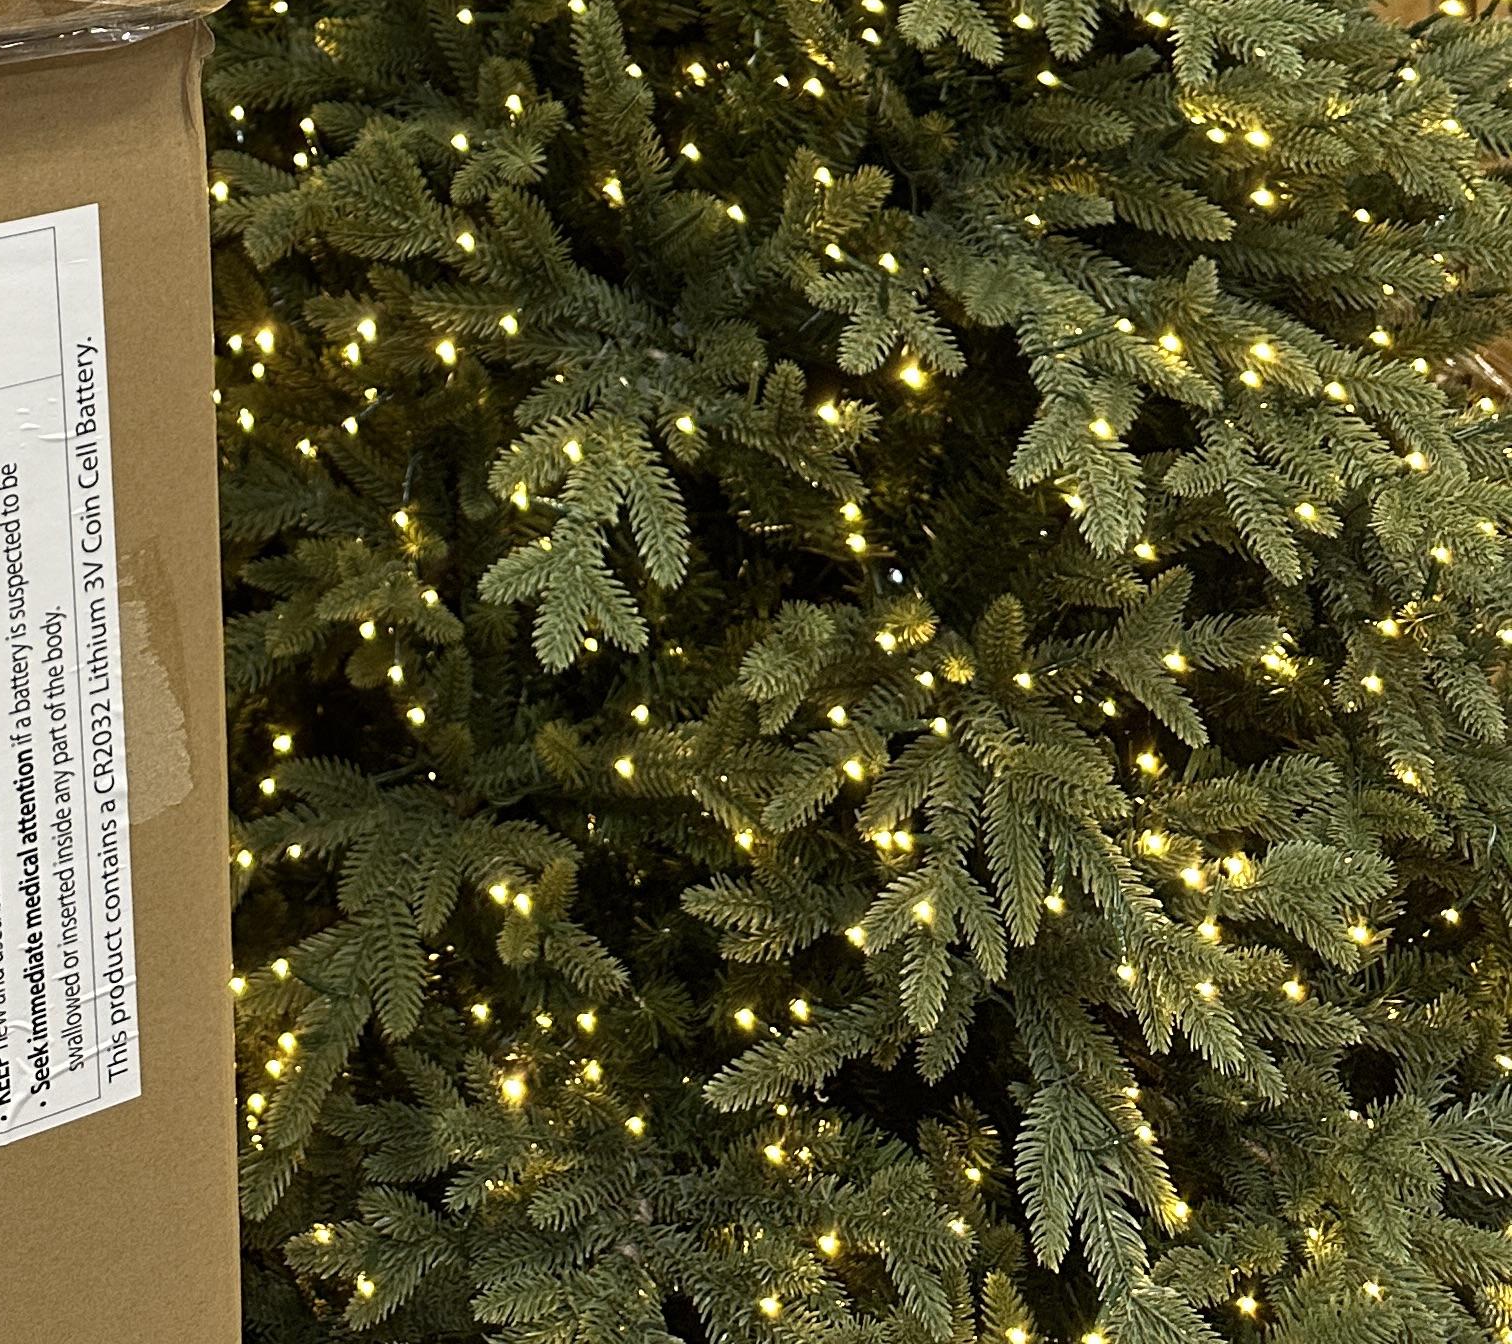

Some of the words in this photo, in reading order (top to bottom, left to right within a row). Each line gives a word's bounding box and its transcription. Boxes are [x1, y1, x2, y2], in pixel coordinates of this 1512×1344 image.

[76, 337, 98, 436] Battery.
[76, 442, 98, 488] Cell
[81, 495, 102, 553] Coin
[83, 563, 104, 592] 3V
[87, 598, 109, 695] Lithium
[91, 699, 114, 793] CR2032
[101, 799, 115, 813] a
[98, 820, 121, 922] contains
[103, 927, 131, 1025] product
[107, 1031, 128, 1083] This
